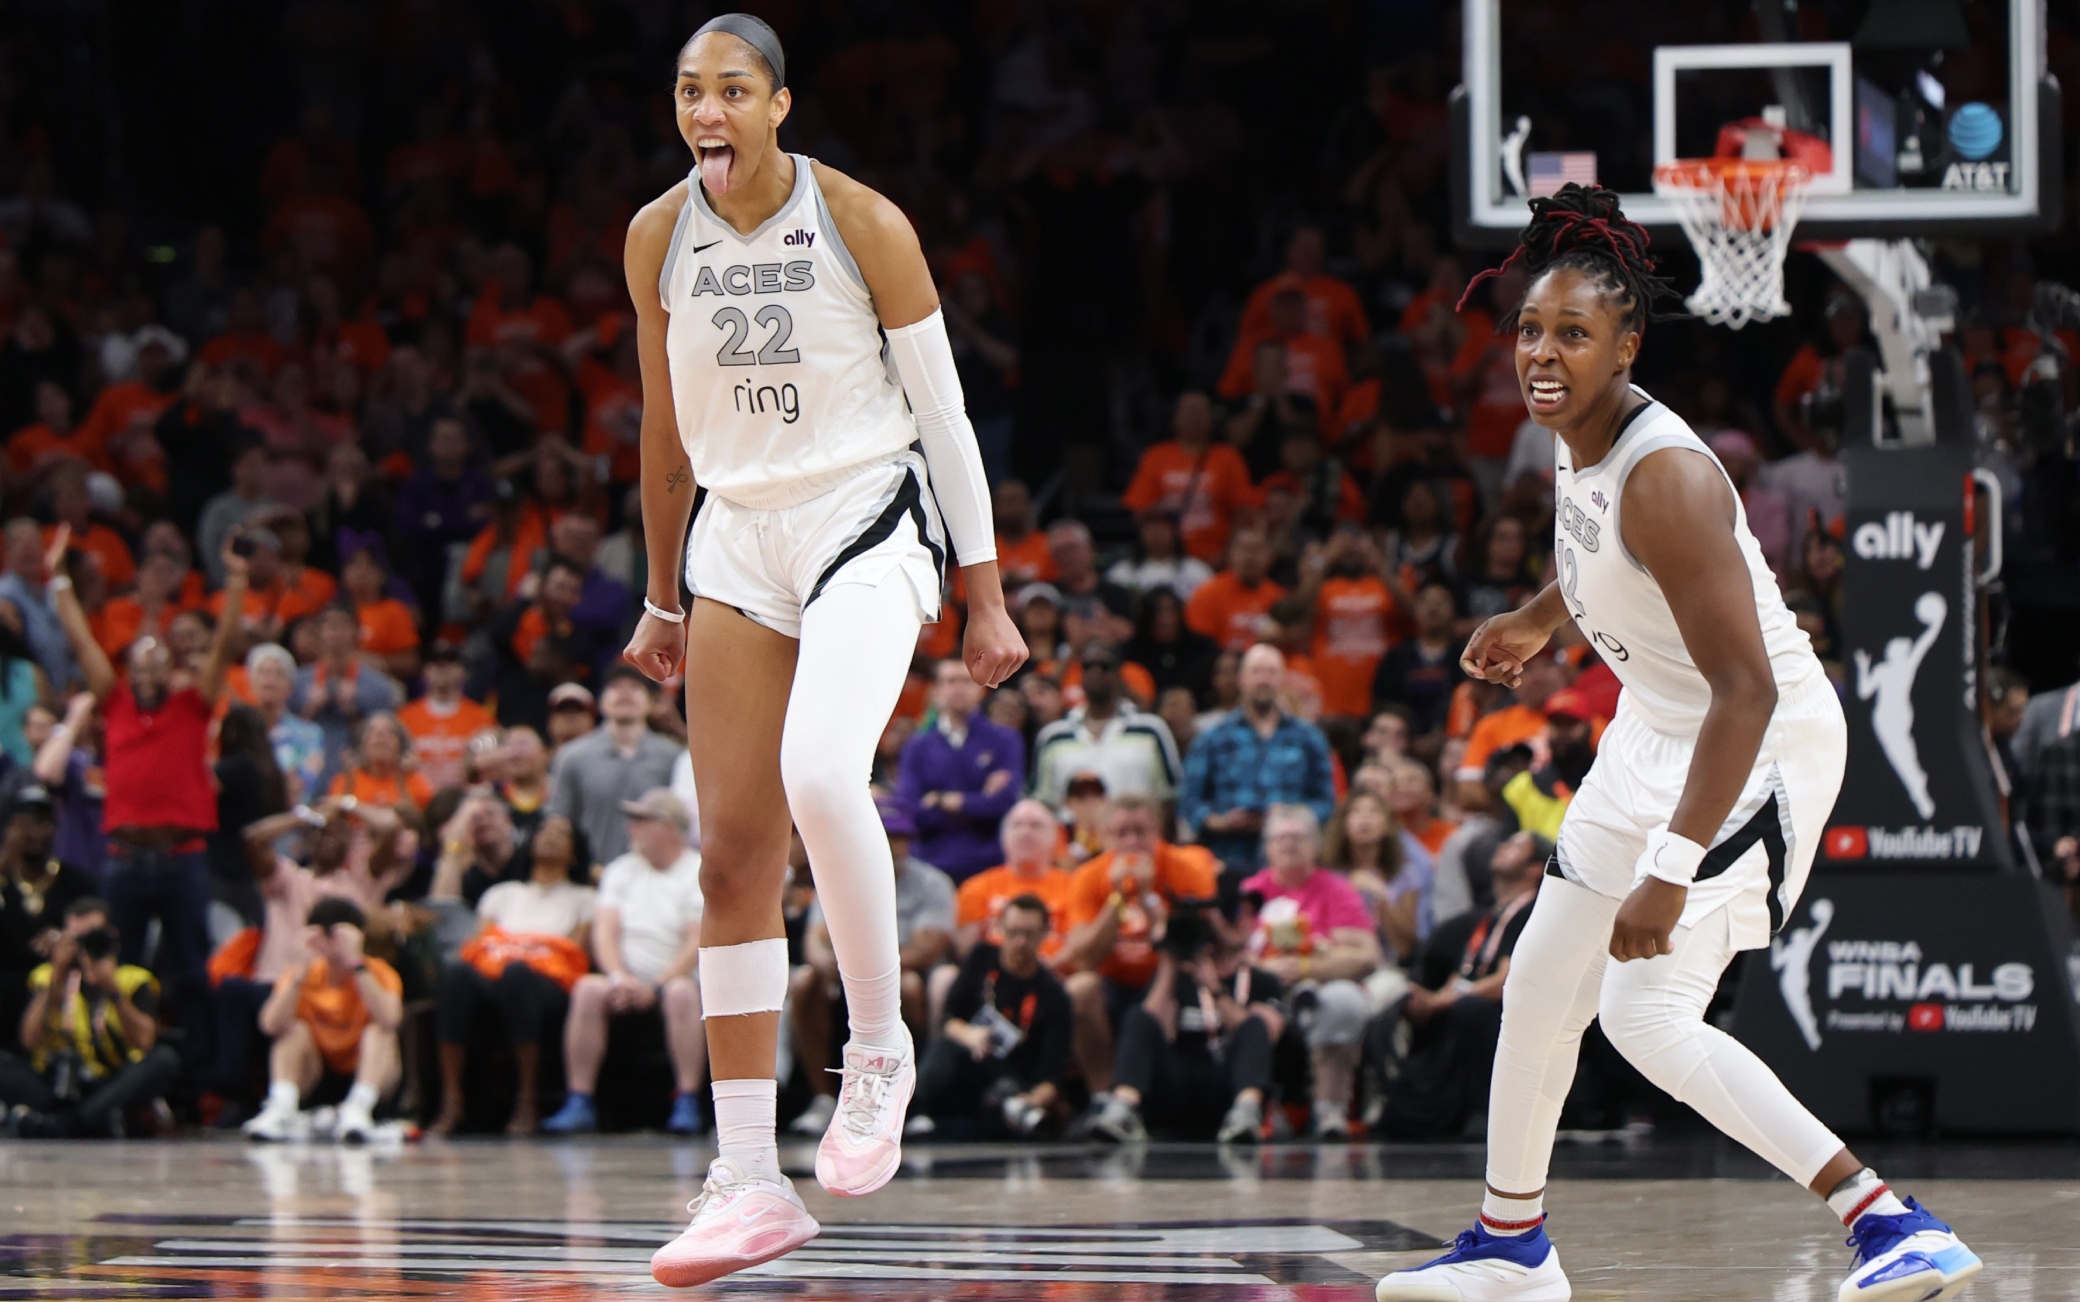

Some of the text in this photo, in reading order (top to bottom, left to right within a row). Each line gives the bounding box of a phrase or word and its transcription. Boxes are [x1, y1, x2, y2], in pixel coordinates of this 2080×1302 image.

[1941, 162, 2009, 191] AT&T
[783, 229, 816, 248] ally
[691, 260, 816, 297] ACES
[711, 304, 800, 367] 22
[734, 378, 800, 424] ring
[1591, 490, 1609, 515] ally
[1853, 511, 1945, 570] ally
[1952, 826, 1983, 859] TV
[1827, 941, 1923, 962] WNBA
[1827, 963, 2035, 1000] FINALS
